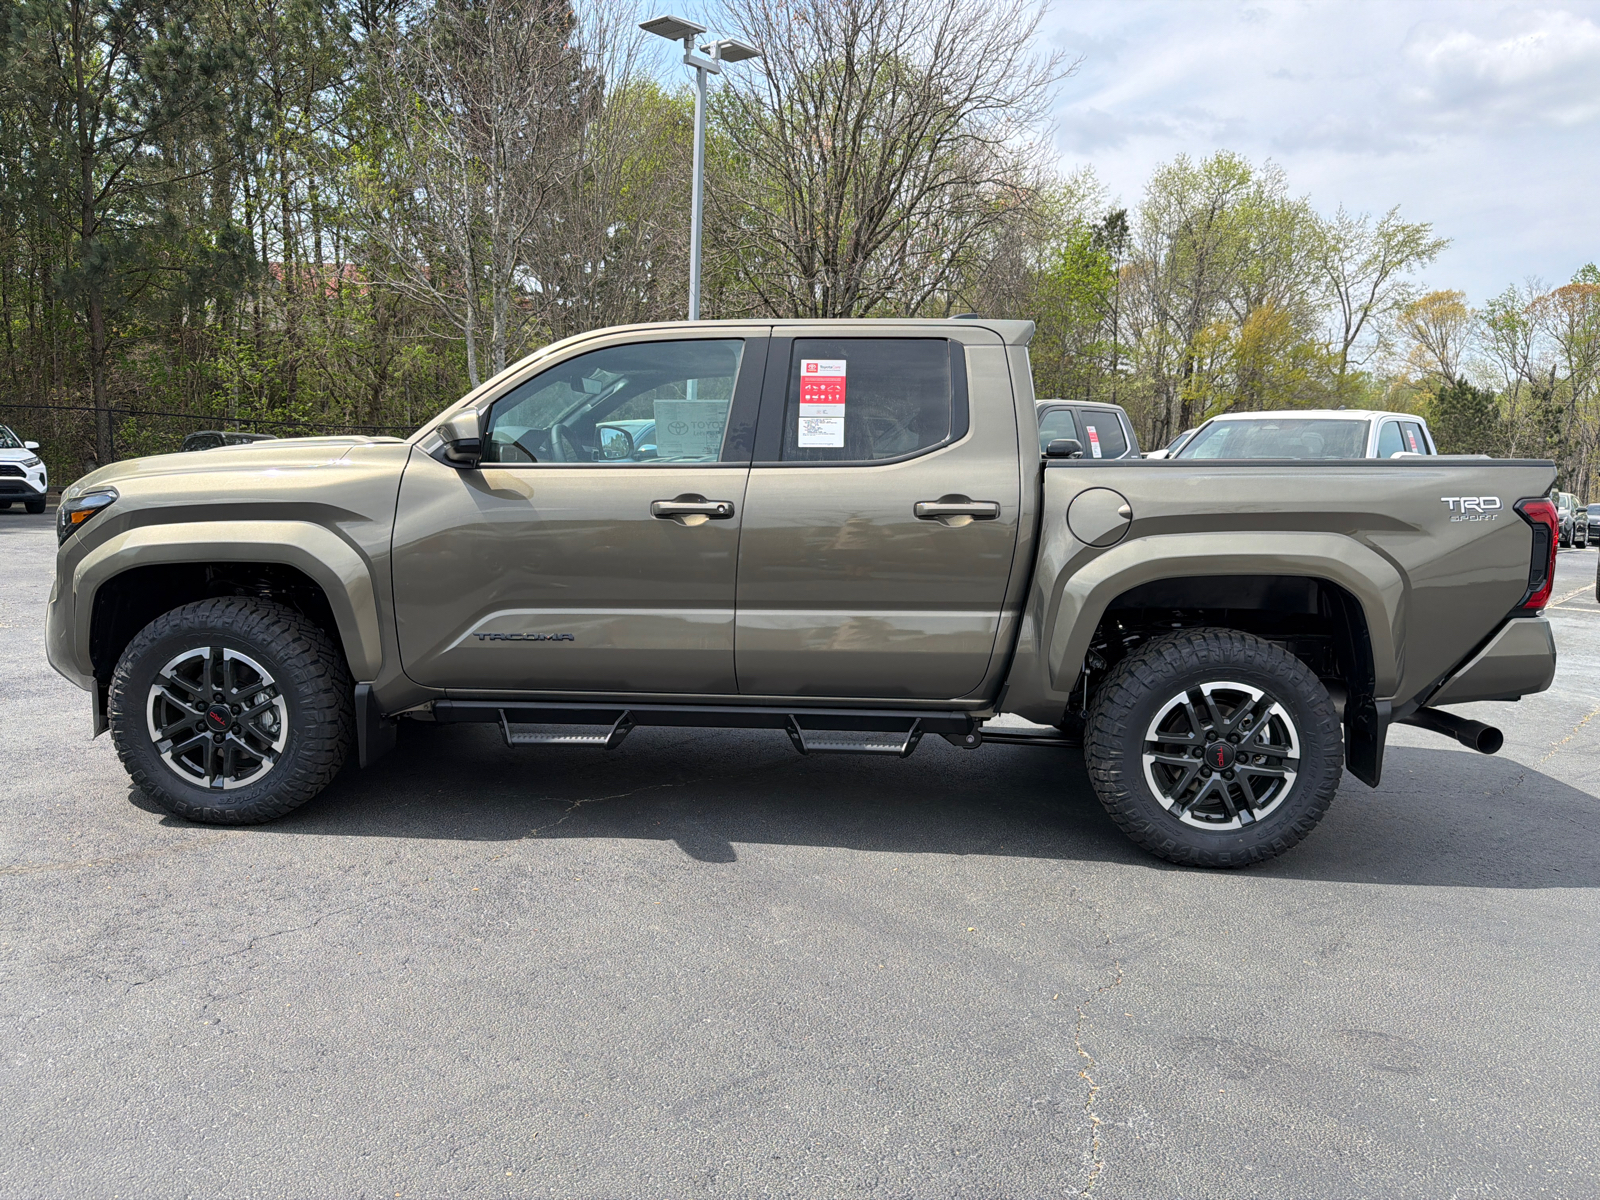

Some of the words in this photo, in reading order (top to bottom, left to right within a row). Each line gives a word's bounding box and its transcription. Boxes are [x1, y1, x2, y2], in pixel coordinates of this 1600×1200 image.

[1440, 496, 1503, 514] TRD
[1450, 514, 1498, 523] SPORT
[472, 632, 575, 641] TACOMA
[209, 711, 226, 726] TRD
[1216, 746, 1225, 767] TRD
